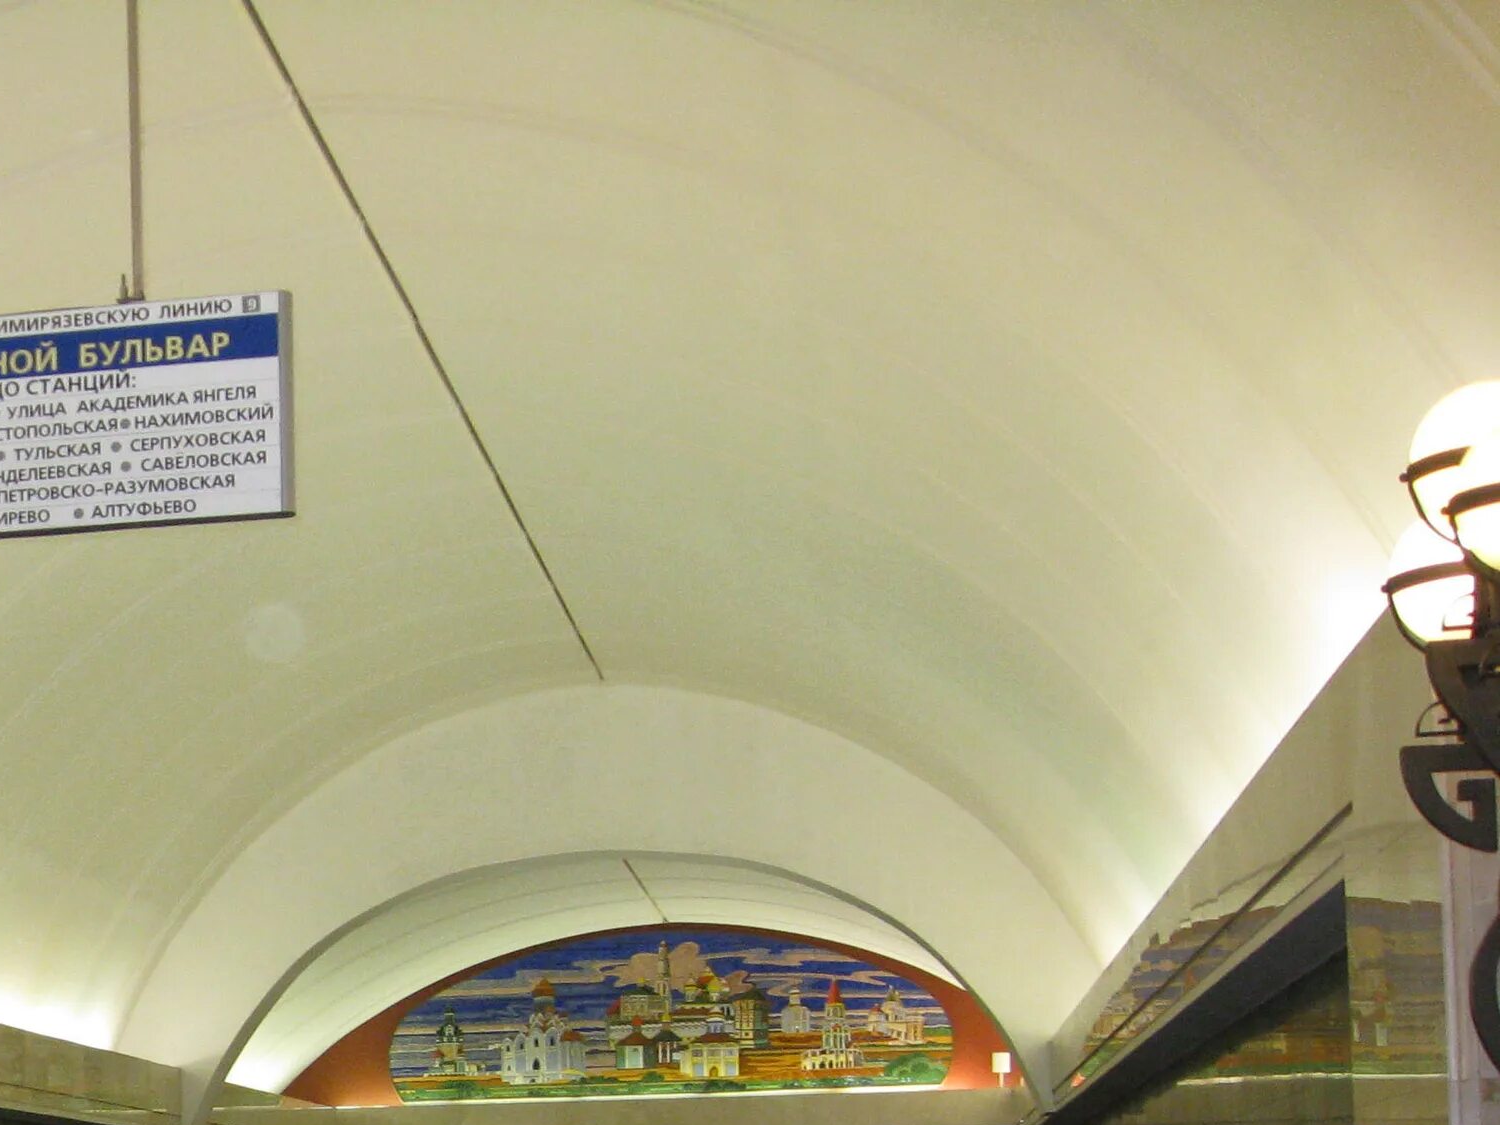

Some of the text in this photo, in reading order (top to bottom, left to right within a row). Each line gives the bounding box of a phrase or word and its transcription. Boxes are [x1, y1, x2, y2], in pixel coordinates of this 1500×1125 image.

[159, 299, 232, 320] ЛИНИЮ
[79, 332, 230, 369] БУЛЬВАР
[7, 402, 67, 420] УЛИЦА
[77, 391, 189, 414] АКАДЕМИКА
[193, 385, 257, 404] ЯНГЕЛЯ
[134, 402, 275, 430] НАХИМОВСКИЙ
[14, 442, 101, 461] ТУЛЬСКАЯ
[130, 429, 267, 452] СЕРПУХОВСКАЯ
[91, 499, 197, 519] АЛТУФЬЕВО
